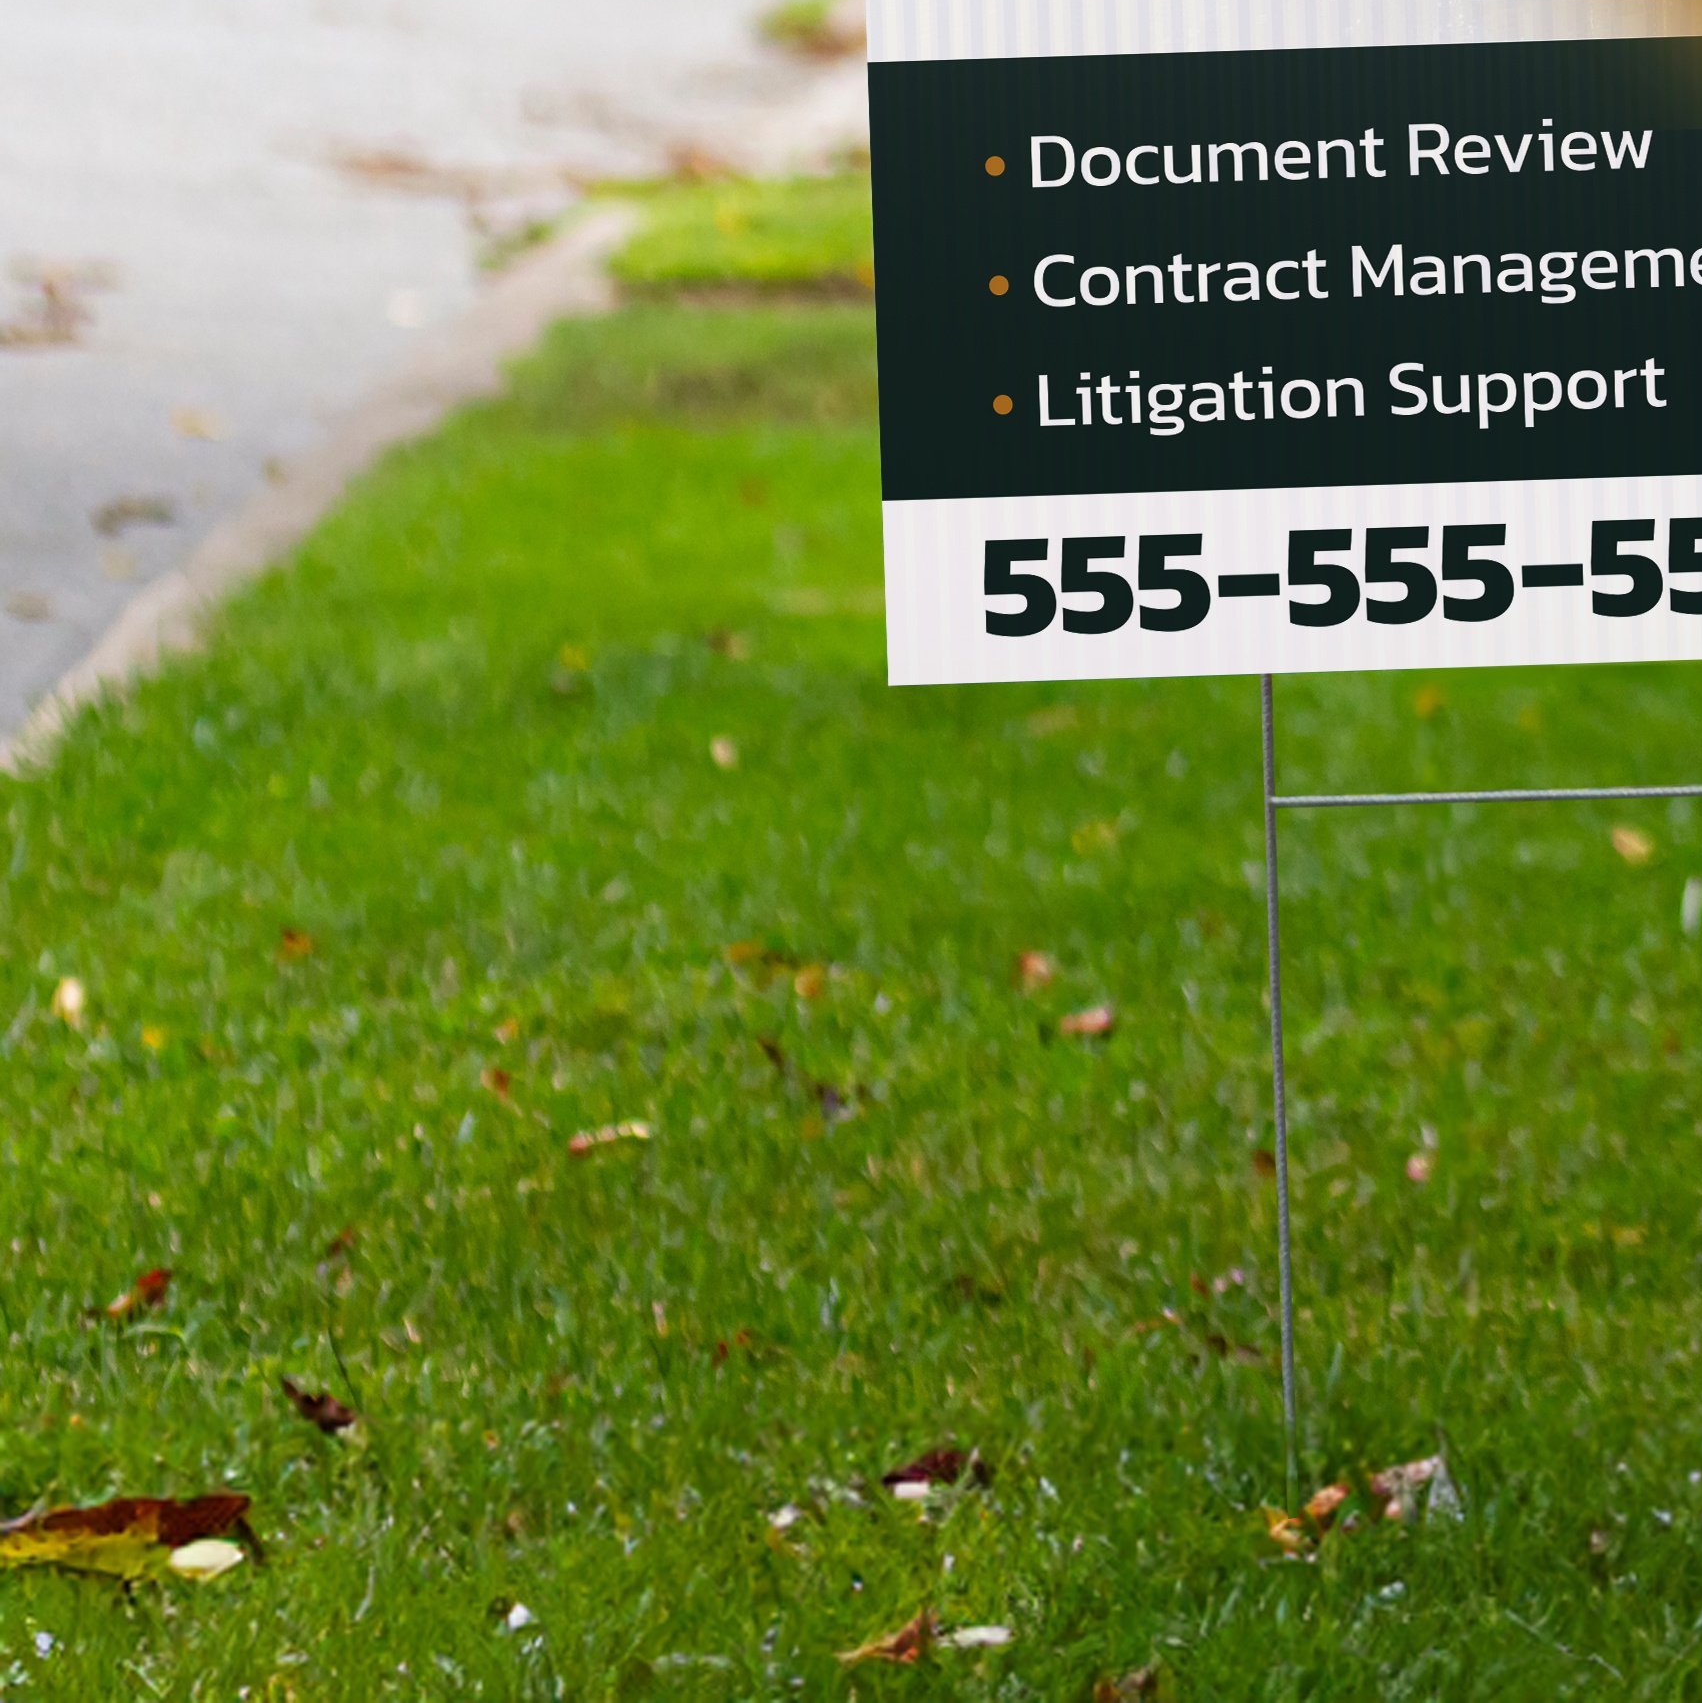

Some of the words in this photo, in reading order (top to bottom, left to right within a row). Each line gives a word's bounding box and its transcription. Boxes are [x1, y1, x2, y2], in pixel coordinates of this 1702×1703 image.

[1029, 123, 1387, 189] Document
[1407, 116, 1655, 177] Review
[1032, 247, 1328, 309] Contract
[1036, 365, 1368, 438] Litigation
[1389, 356, 1668, 429] Support
